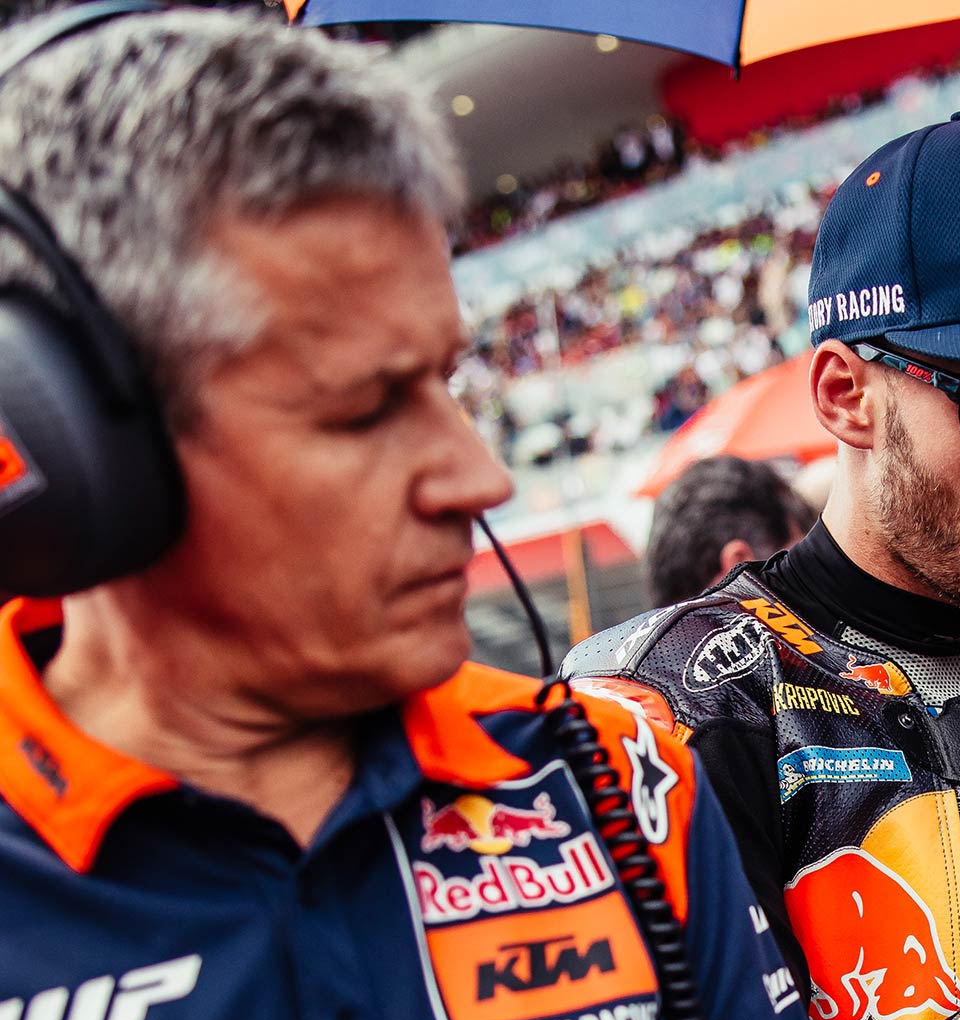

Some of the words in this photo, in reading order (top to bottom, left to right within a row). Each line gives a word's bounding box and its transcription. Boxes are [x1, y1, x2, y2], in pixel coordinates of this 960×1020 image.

[836, 284, 905, 322] RACING
[905, 363, 932, 381] 100%
[740, 598, 824, 655] KTM
[803, 758, 895, 772] MICHELIN
[414, 857, 510, 923] Red
[505, 832, 615, 907] Bull
[477, 935, 617, 1002] KTM
